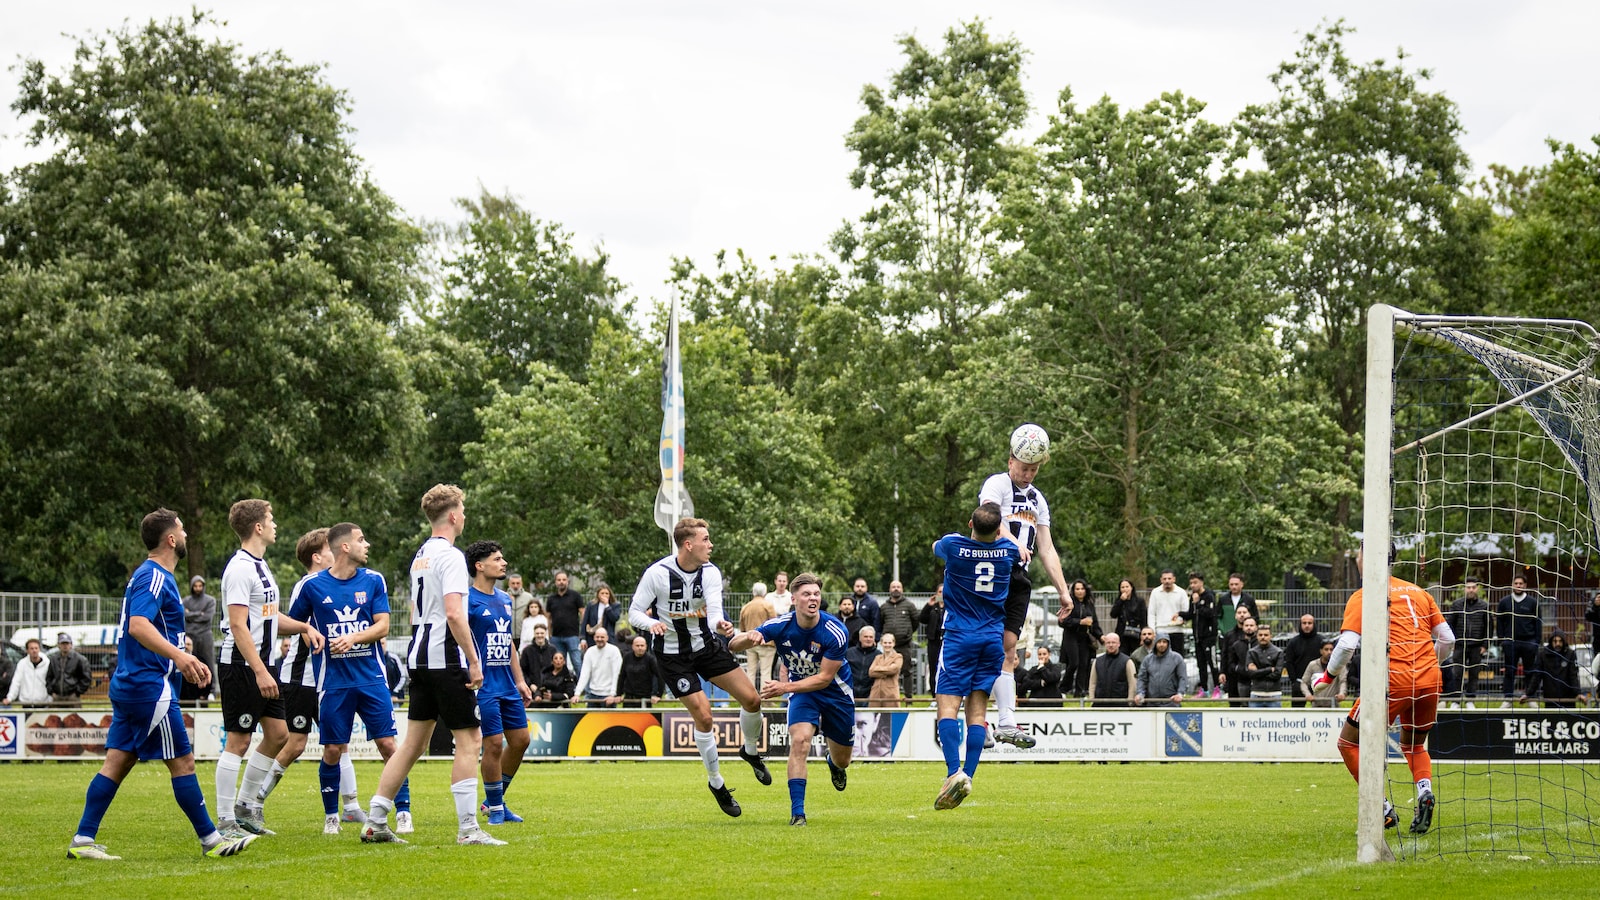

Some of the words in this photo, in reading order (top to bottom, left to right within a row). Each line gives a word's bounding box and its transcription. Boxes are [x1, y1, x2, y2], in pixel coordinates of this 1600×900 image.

[959, 548, 971, 558] FC
[972, 549, 1008, 558] SURYOYE
[975, 562, 994, 592] 2
[668, 600, 689, 612] TEN
[326, 620, 370, 637] KING
[486, 632, 512, 646] KING
[1220, 717, 1236, 728] Uw
[1242, 717, 1306, 729] reclamebord
[1312, 718, 1332, 728] ook
[769, 735, 787, 746] MET
[1241, 731, 1262, 742] Hvv
[1268, 731, 1311, 744] Hengelo
[1316, 731, 1328, 743] ??
[1514, 742, 1590, 754] MAKELAARS
